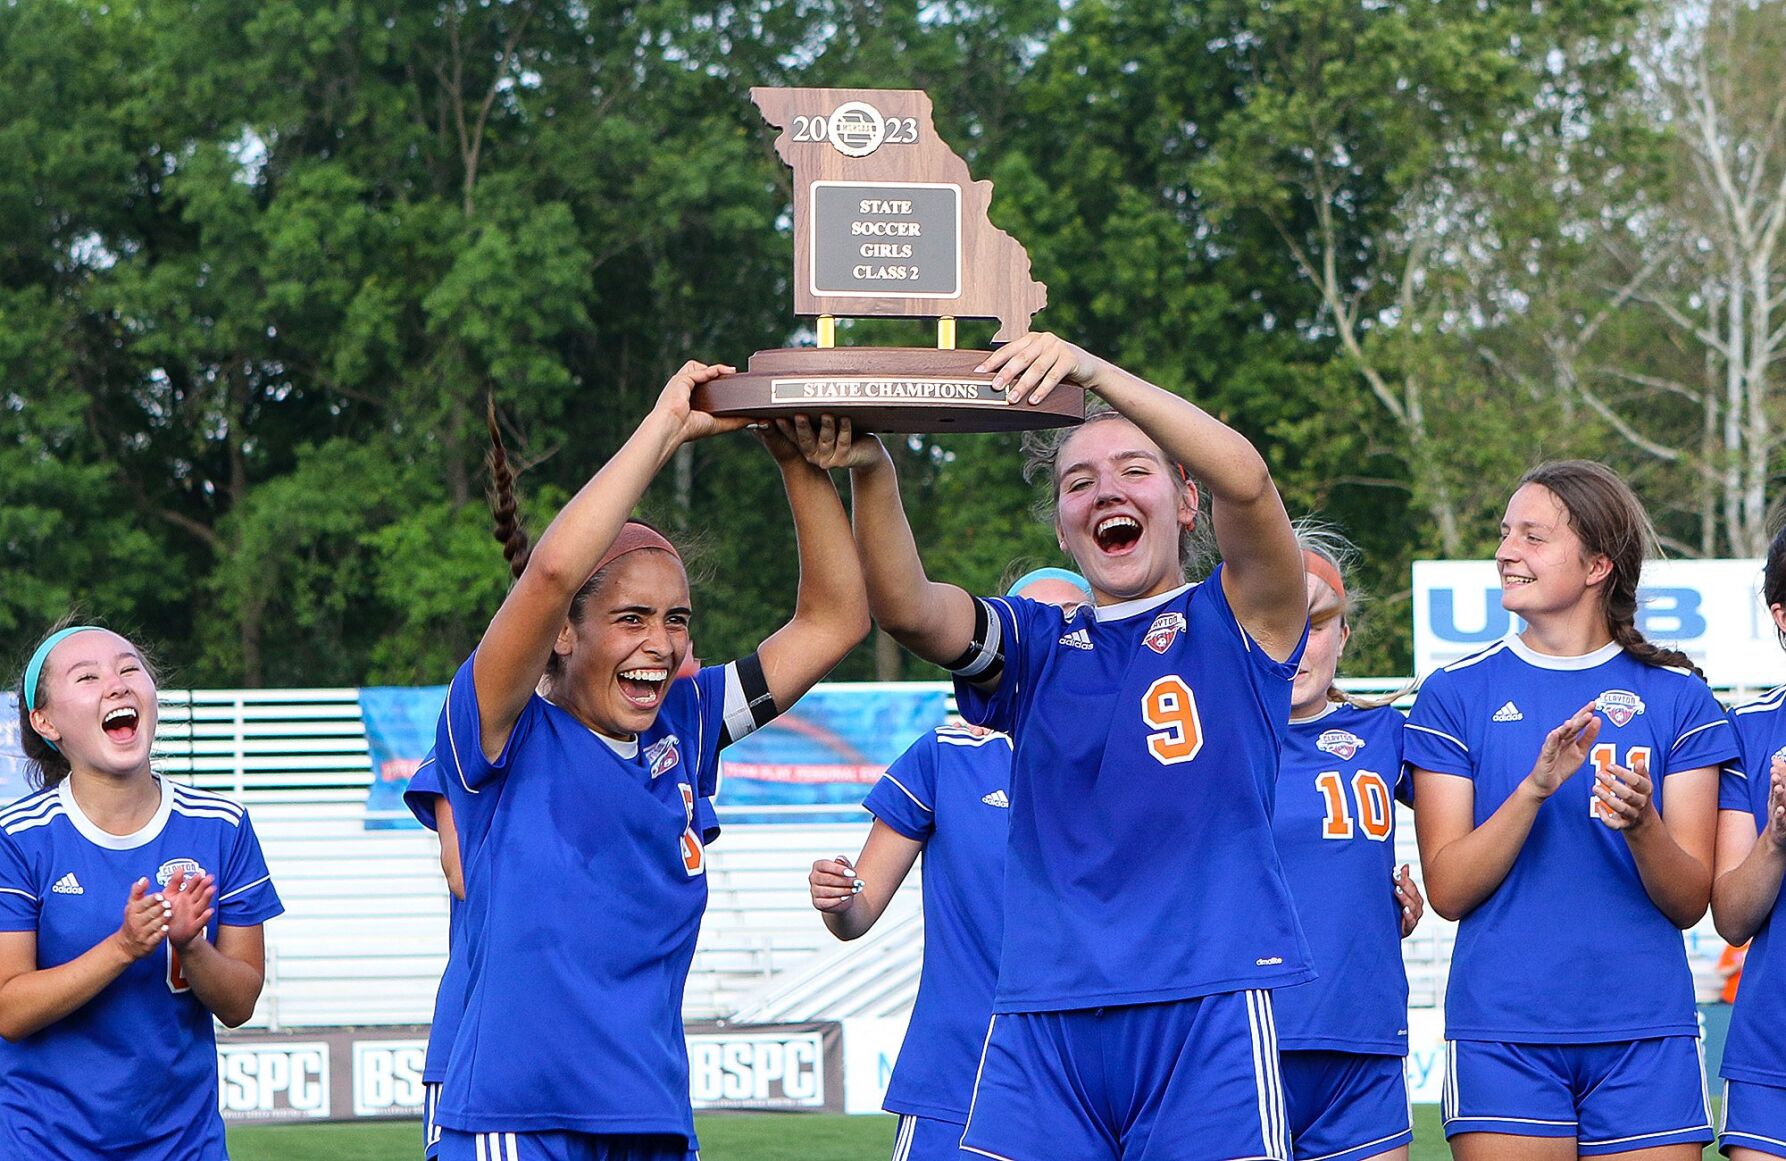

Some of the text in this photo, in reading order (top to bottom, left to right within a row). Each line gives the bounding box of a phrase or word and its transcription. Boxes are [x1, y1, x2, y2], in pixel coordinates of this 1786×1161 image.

[859, 199, 913, 214] STATE
[851, 221, 921, 237] SOCCER
[859, 243, 913, 258] GIRLS
[852, 264, 920, 280] CLASS 2
[803, 382, 979, 399] STATE CHAMPIONS
[1427, 587, 1707, 643] UB
[1141, 675, 1204, 766] 9
[1315, 769, 1393, 842] 10
[218, 1051, 322, 1111] SPC
[692, 1040, 816, 1100] BSPC
